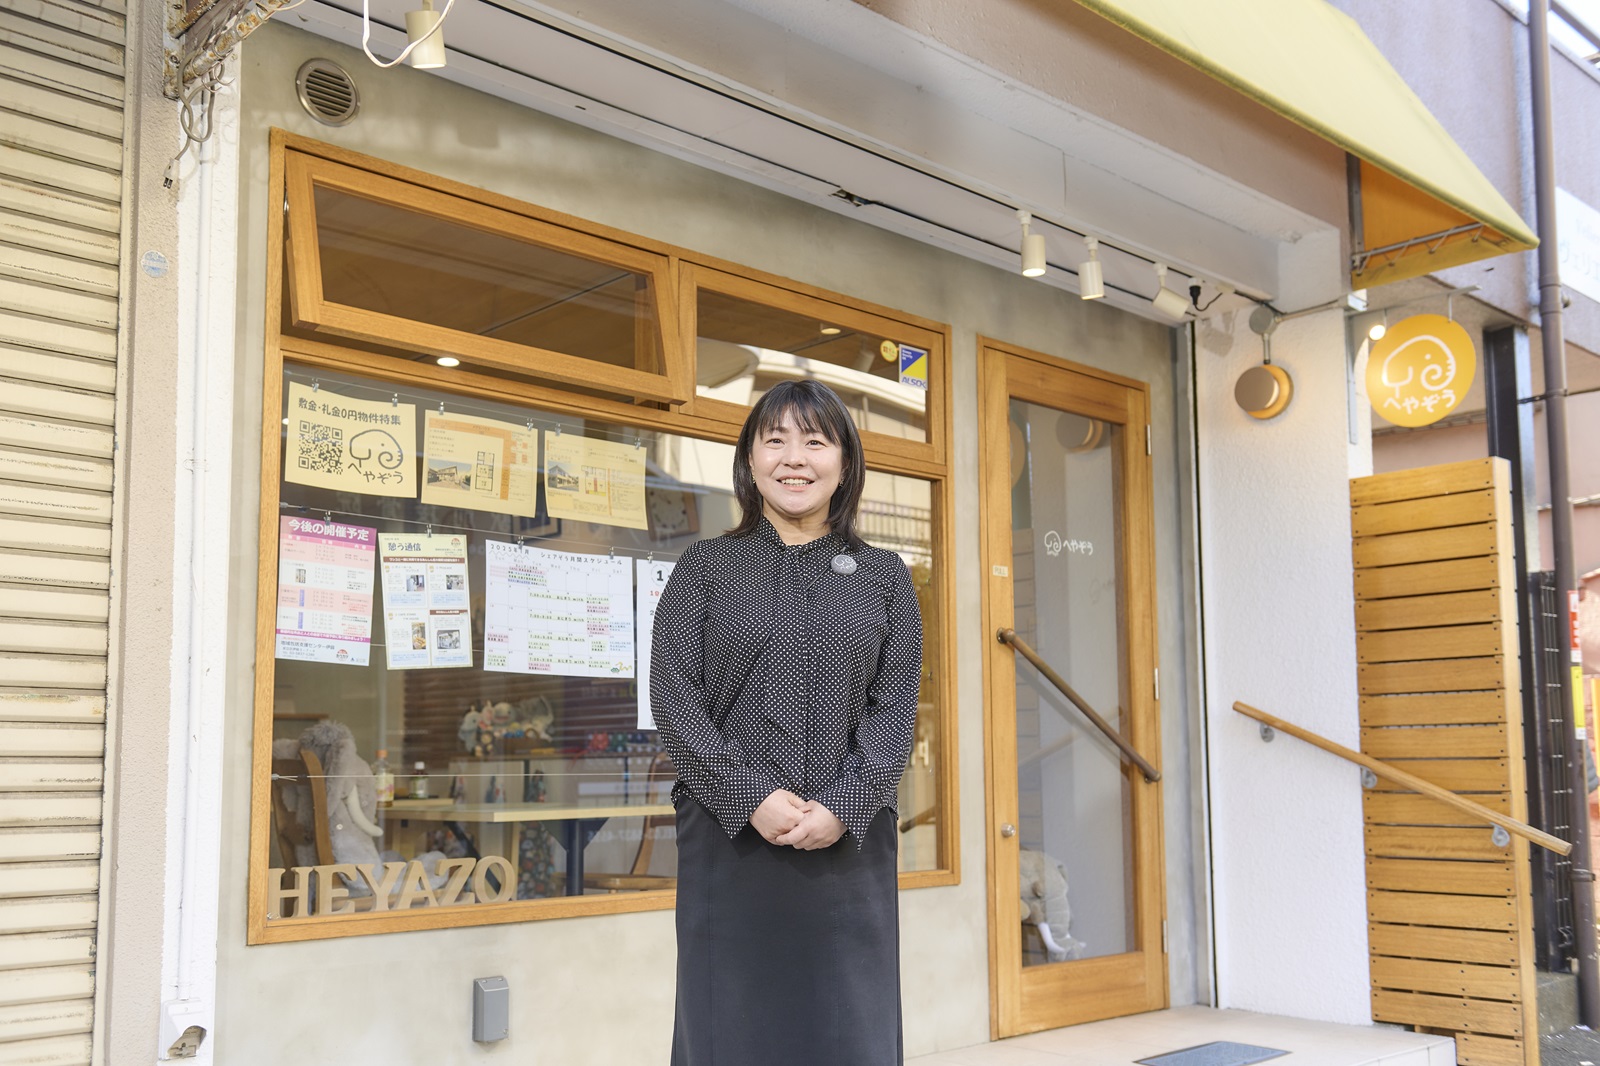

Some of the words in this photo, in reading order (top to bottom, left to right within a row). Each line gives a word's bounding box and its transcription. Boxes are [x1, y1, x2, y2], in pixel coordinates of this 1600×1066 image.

[901, 377, 927, 389] ALSOK
[298, 397, 401, 425] 敷金・礼金0円物件特集
[1383, 389, 1456, 415] へやぞう
[347, 463, 403, 484] へやぞう
[288, 518, 369, 541] 今後の開催予定
[1063, 539, 1093, 556] へやぞう
[656, 570, 664, 581] 1
[267, 855, 516, 919] HEYAZO
